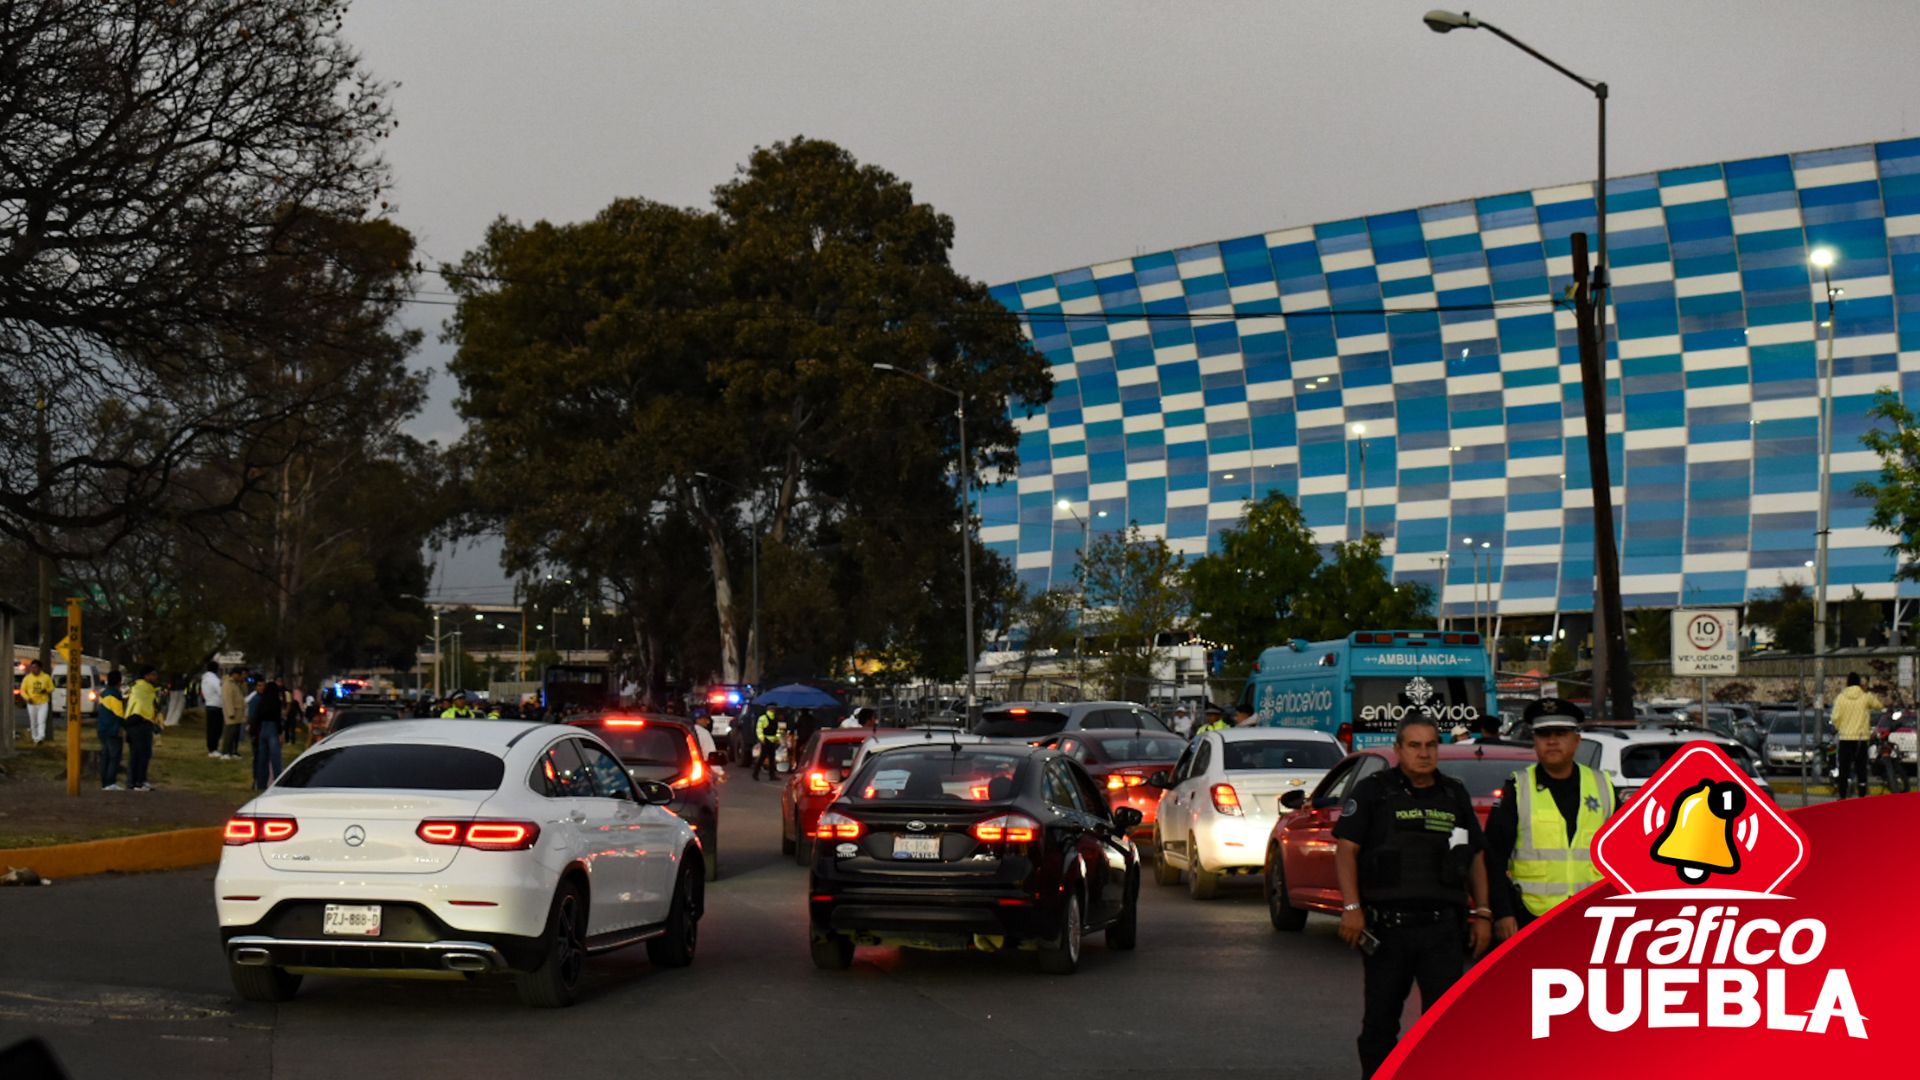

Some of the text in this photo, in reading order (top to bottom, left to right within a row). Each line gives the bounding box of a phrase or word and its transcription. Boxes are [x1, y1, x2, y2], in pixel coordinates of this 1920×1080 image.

[1697, 622, 1715, 635] 10
[1378, 654, 1457, 665] AMBULANCIA
[69, 625, 78, 721] NO CONSTRUIR
